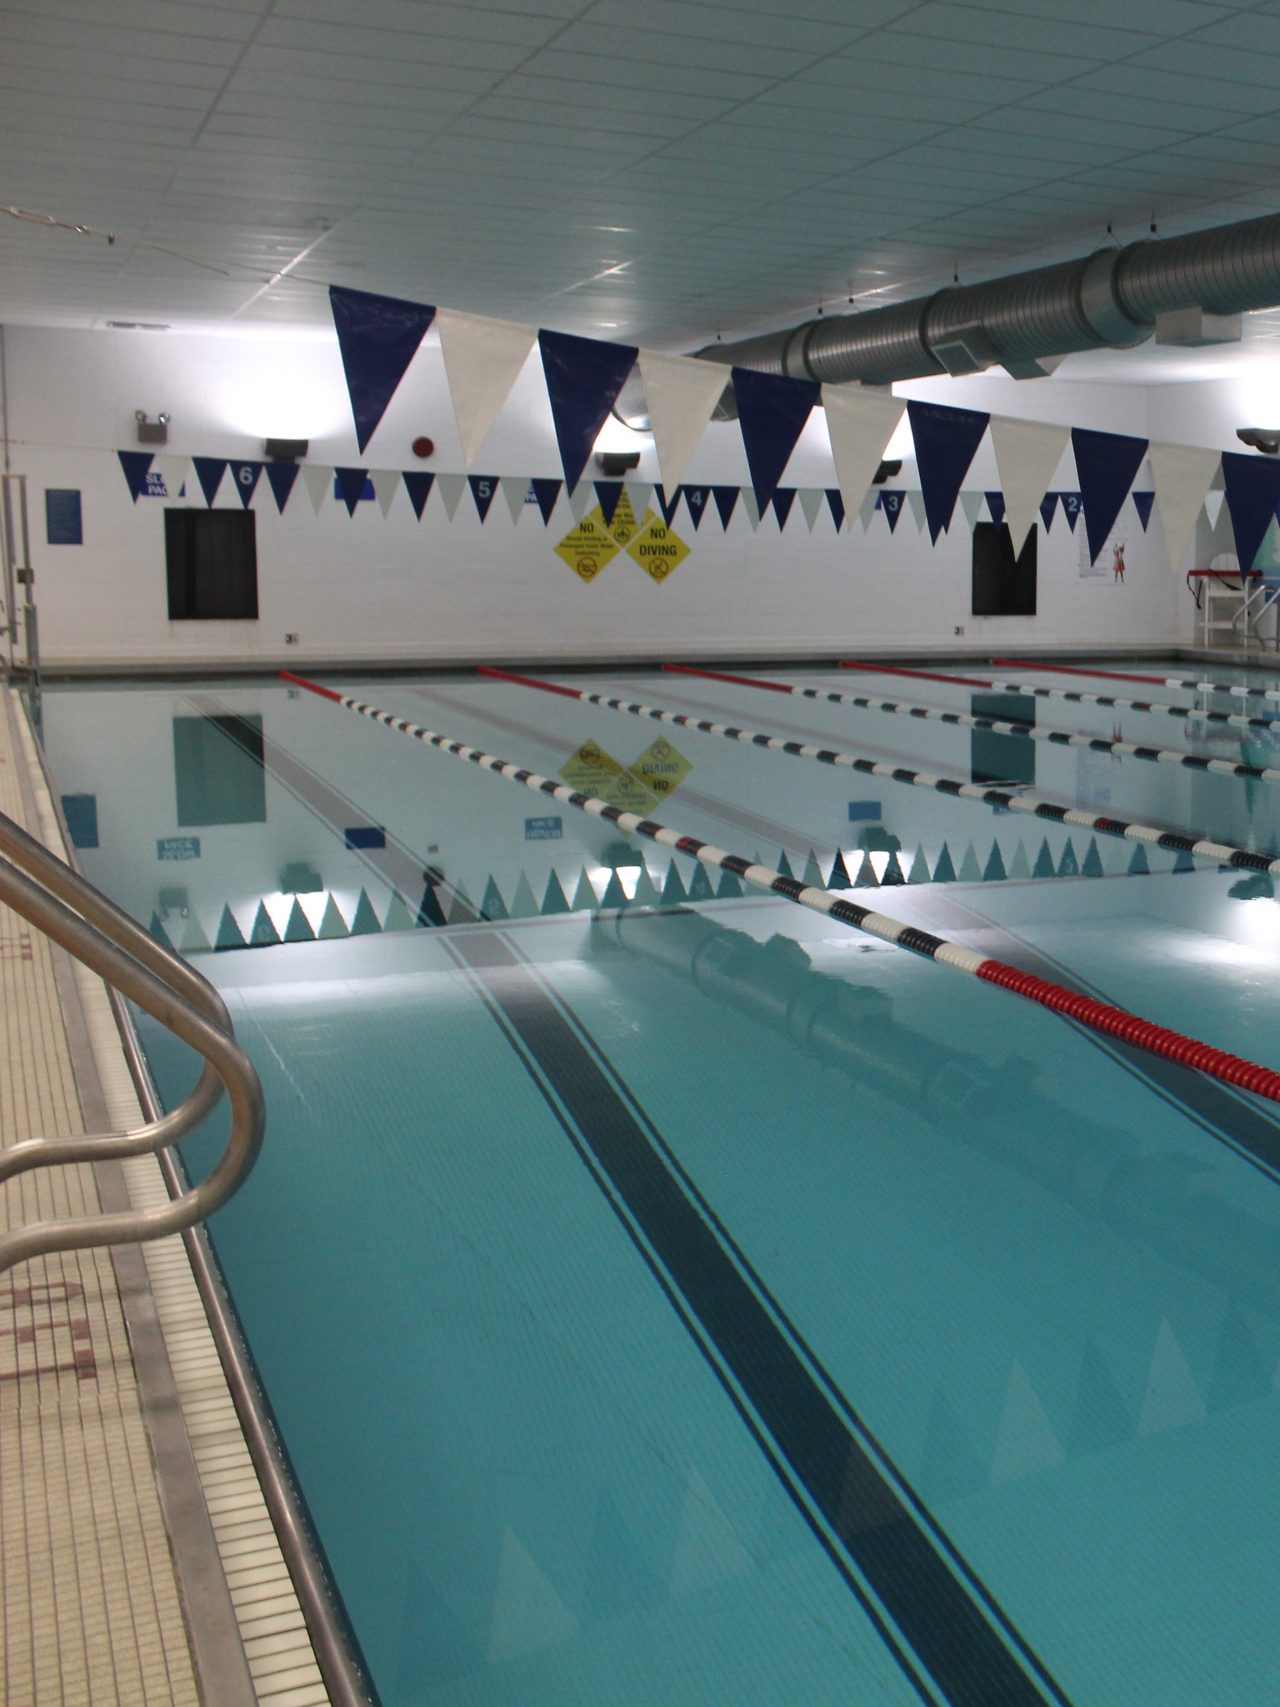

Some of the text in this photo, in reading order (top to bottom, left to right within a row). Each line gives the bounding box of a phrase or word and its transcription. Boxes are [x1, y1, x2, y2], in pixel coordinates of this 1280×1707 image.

[238, 466, 254, 485] 6
[478, 481, 491, 498] 5
[691, 491, 702, 506] 4
[888, 496, 899, 511] 3
[1068, 497, 1079, 512] 2
[580, 523, 594, 533] NO
[650, 528, 666, 539] NO
[639, 545, 677, 556] DIVING
